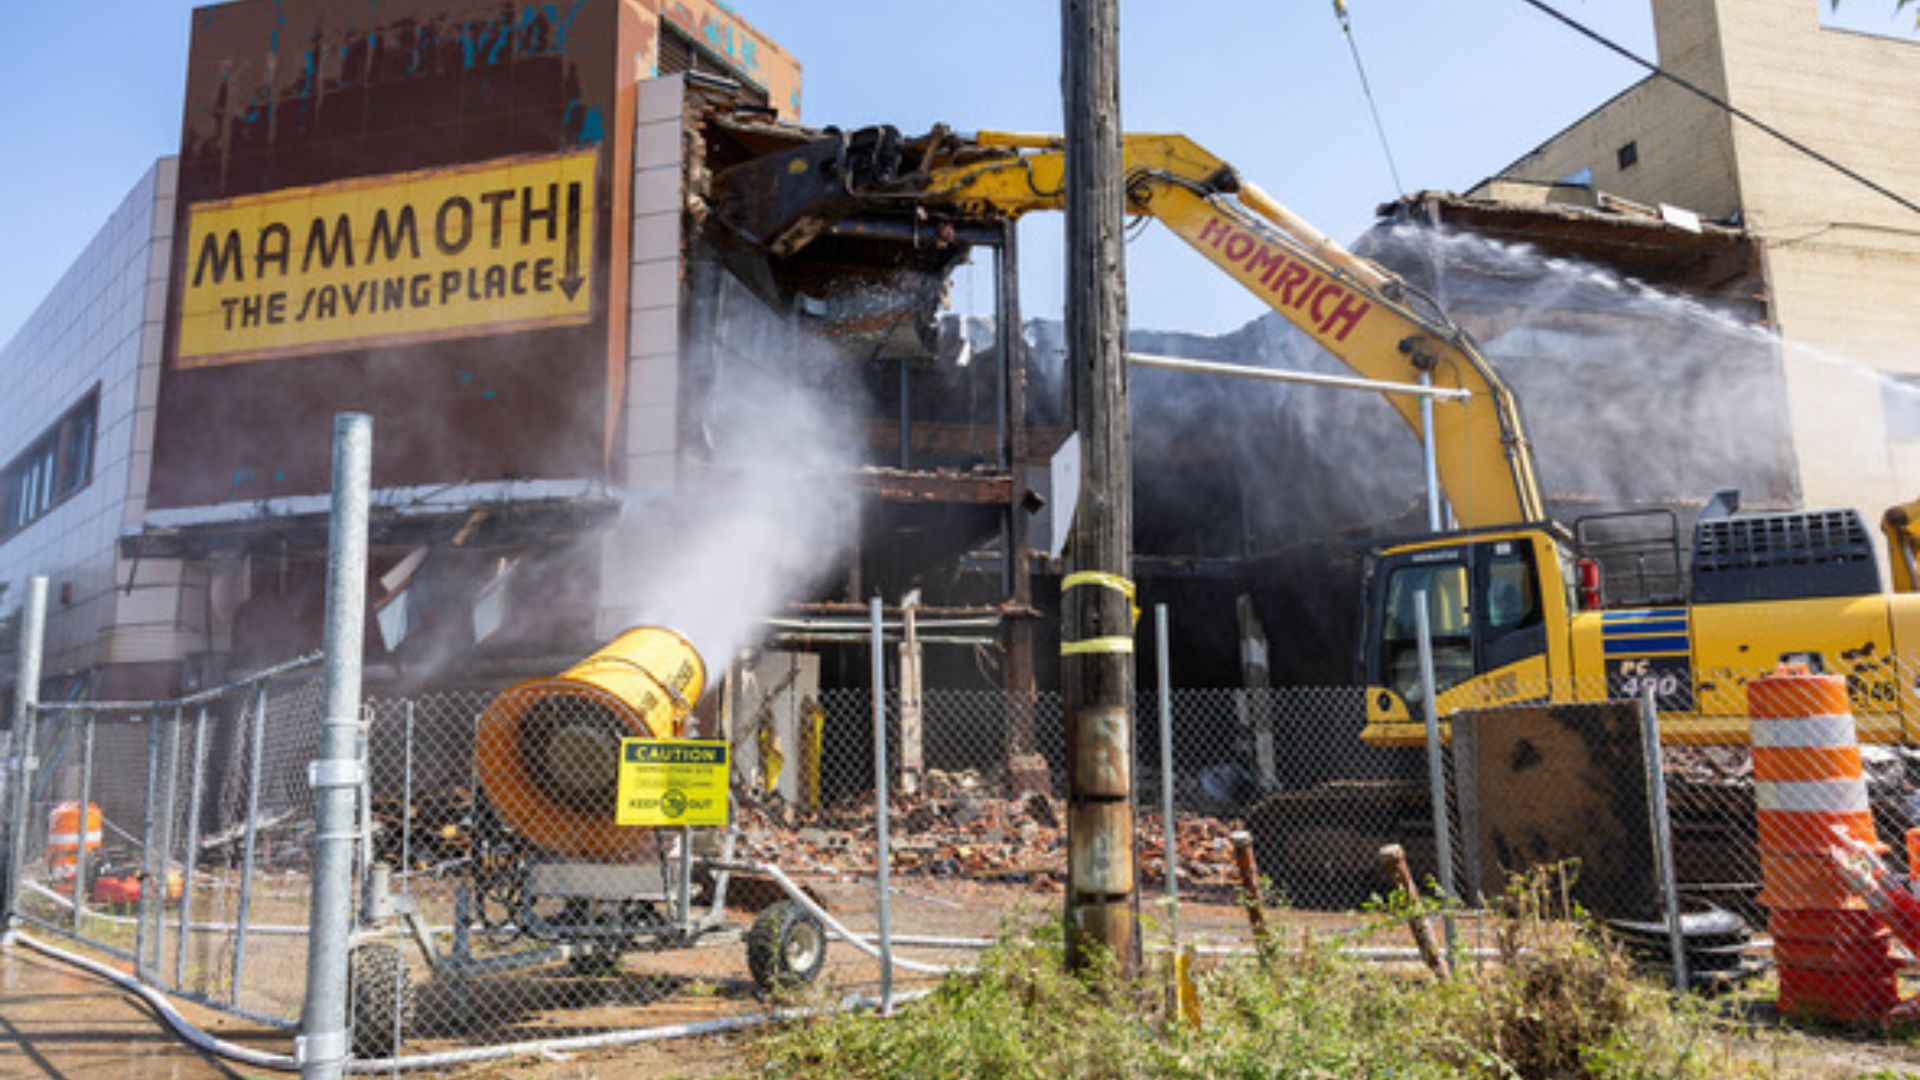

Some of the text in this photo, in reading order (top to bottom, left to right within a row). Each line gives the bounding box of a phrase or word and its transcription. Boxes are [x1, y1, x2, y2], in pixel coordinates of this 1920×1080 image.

[192, 183, 560, 288] MAMMOTH
[221, 257, 555, 331] THE SAVING PLACE
[1197, 216, 1371, 342] HOMRICH
[635, 745, 718, 761] CAUTION
[628, 798, 713, 810] KEEP OUT
